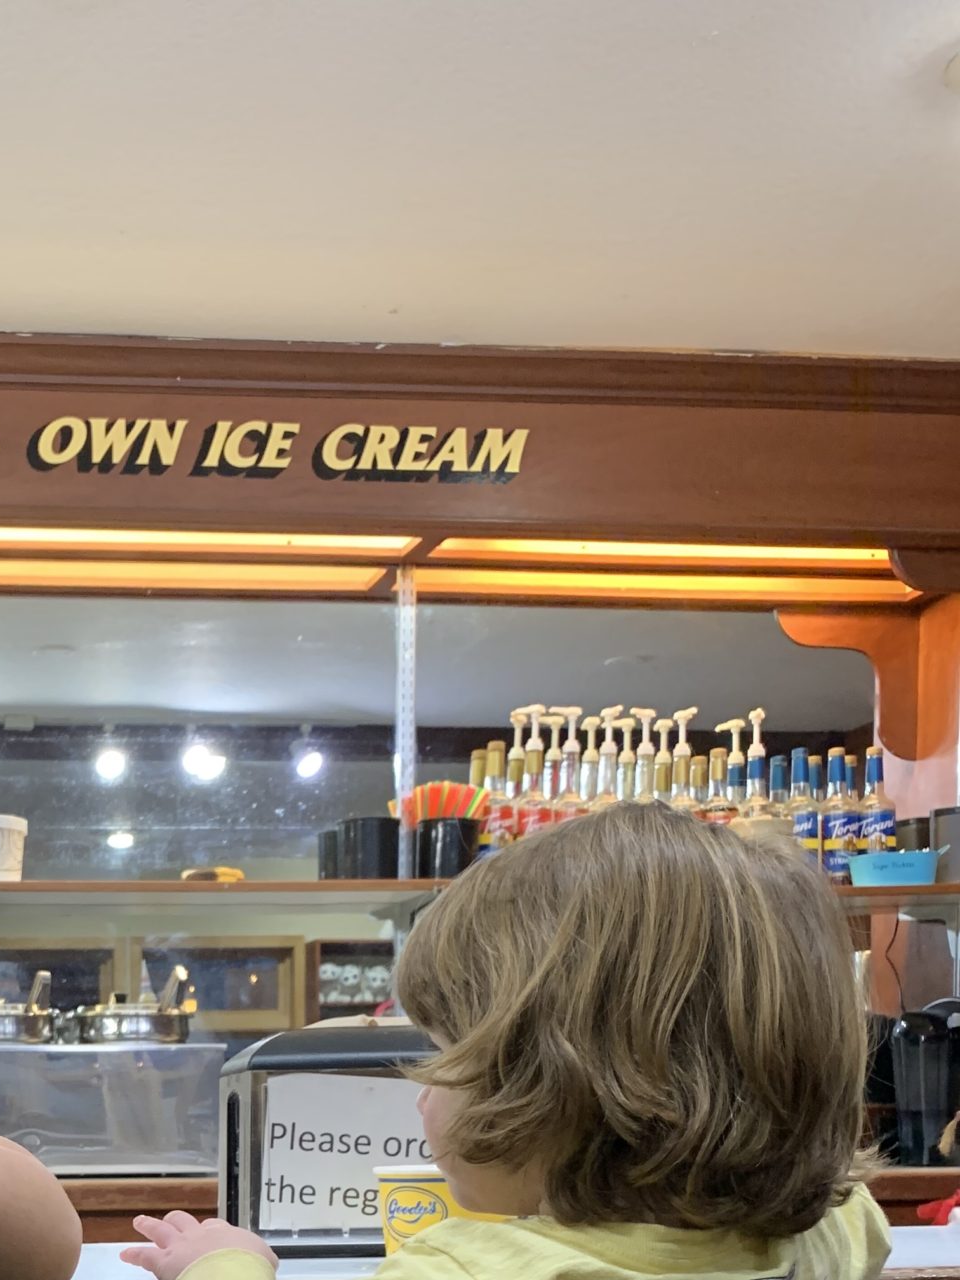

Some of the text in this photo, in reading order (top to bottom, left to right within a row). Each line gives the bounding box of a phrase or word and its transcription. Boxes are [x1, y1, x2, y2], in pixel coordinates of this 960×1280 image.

[38, 416, 188, 467] OWN
[203, 420, 301, 469] ICE
[322, 423, 529, 474] CREAM
[269, 1121, 372, 1156] Please
[264, 1174, 380, 1216] the reg
[386, 1198, 438, 1225] Goody's
